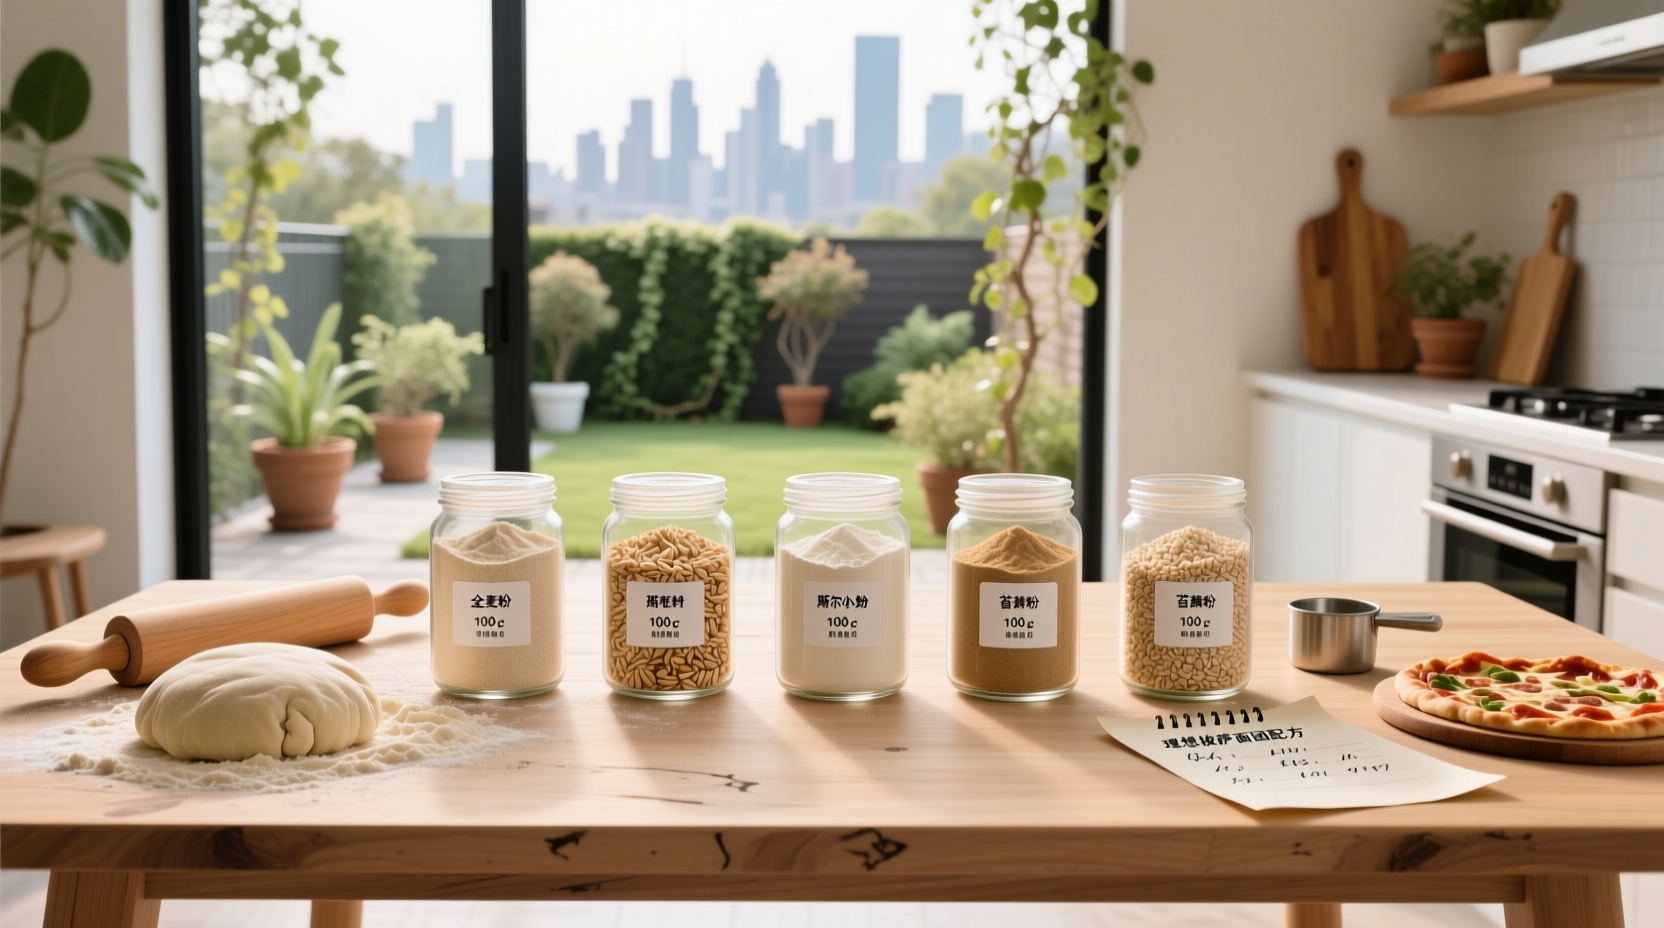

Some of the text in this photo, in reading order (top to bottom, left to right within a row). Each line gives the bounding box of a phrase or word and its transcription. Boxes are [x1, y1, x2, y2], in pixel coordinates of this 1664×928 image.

[474, 616, 496, 627] 100
[649, 616, 671, 628] 100
[826, 616, 849, 628] 100
[1004, 616, 1025, 628] 100
[1179, 616, 1202, 627] 100
